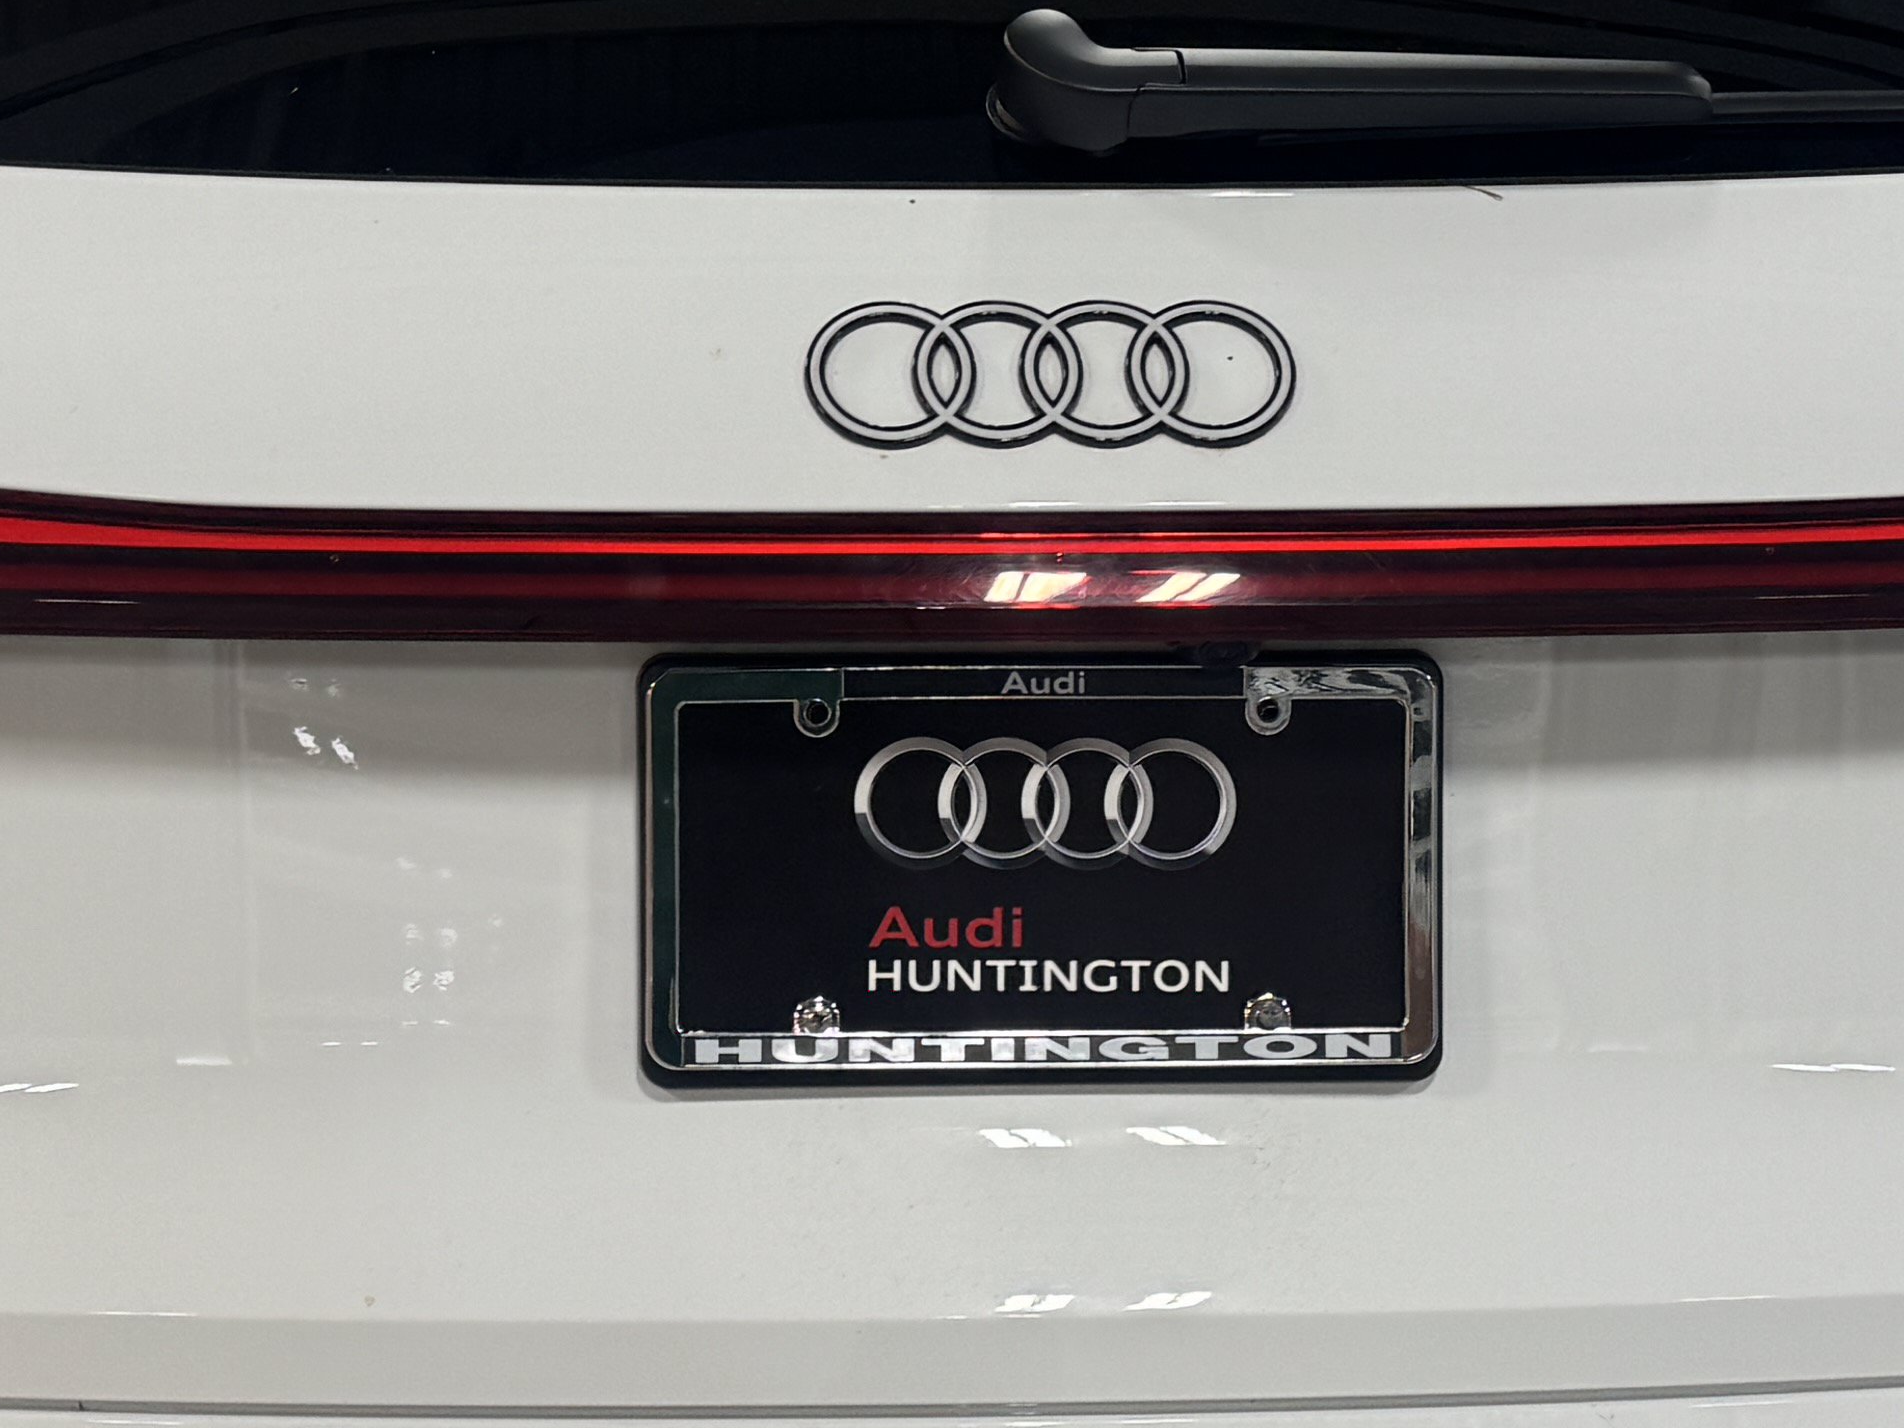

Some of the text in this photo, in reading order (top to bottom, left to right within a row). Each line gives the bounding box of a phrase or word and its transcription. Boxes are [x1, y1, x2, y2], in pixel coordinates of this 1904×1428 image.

[1000, 670, 1086, 694] Audi
[868, 905, 1024, 949] Audi
[867, 959, 1230, 993] HUNTINGTON
[695, 1034, 1392, 1063] HUNTINGTON
